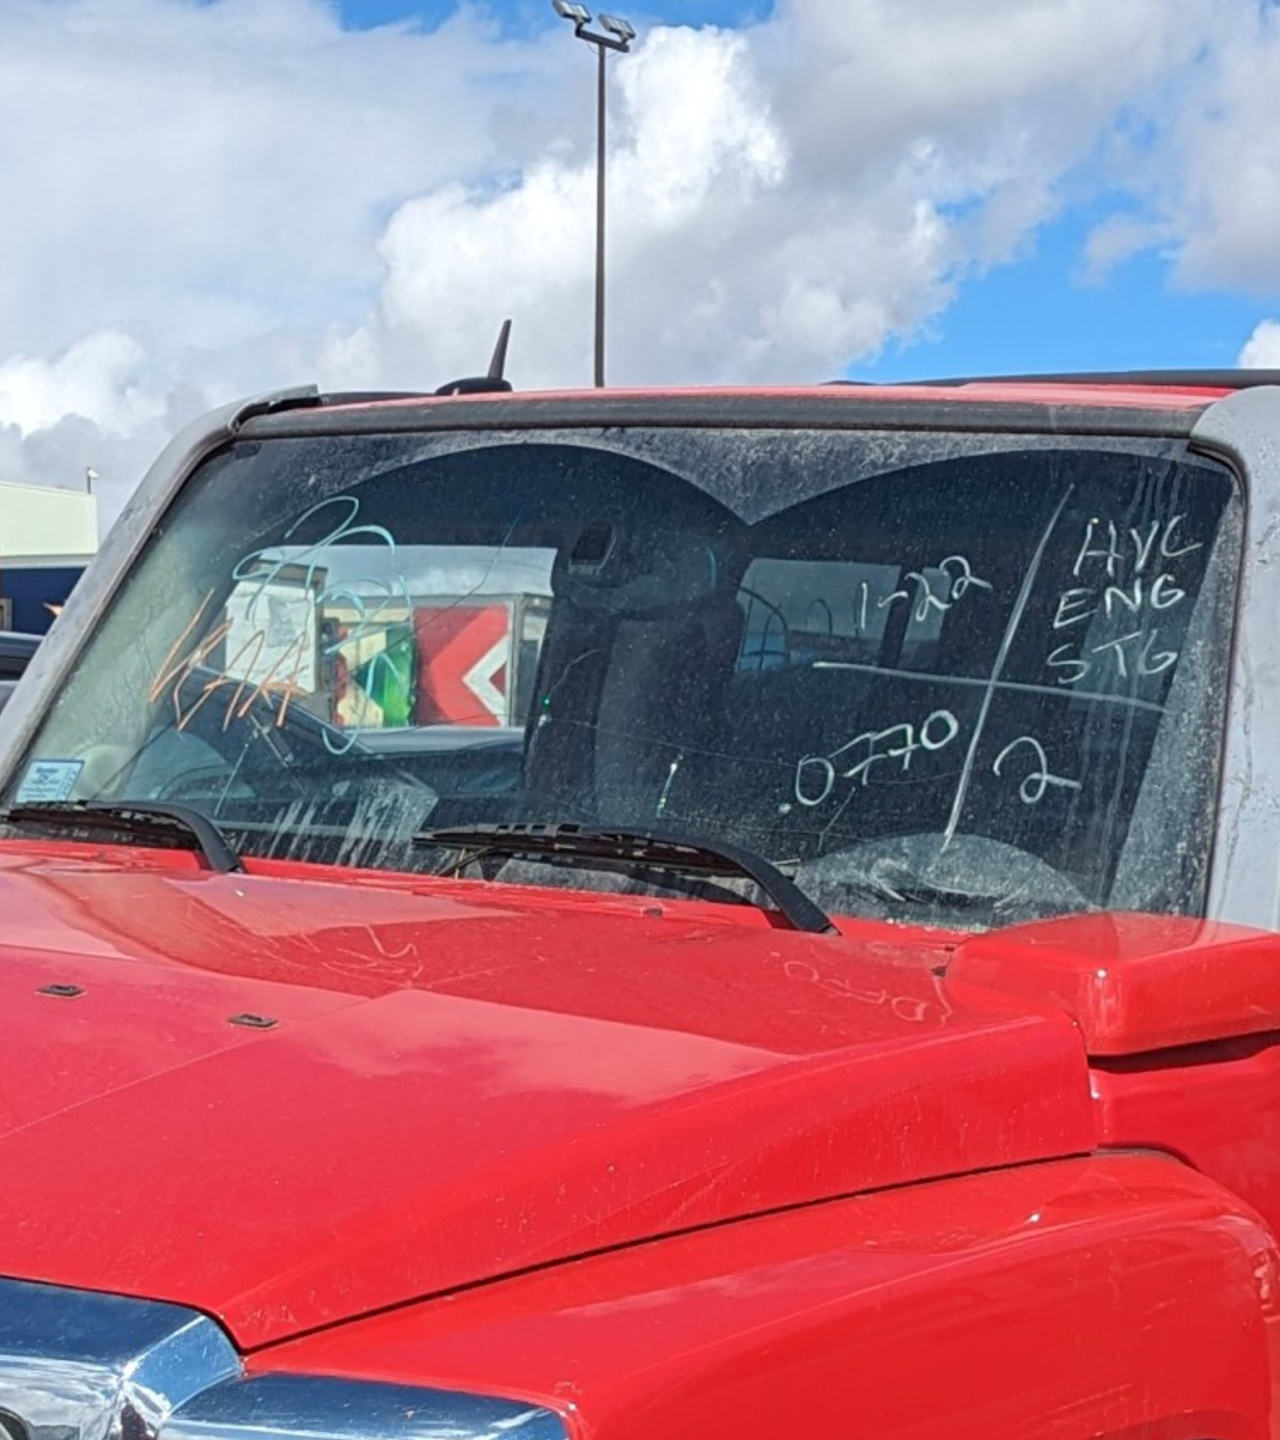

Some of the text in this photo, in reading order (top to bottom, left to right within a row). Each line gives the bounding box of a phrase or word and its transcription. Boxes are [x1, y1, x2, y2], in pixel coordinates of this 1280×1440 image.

[1051, 574, 1186, 629] ENG
[1047, 631, 1178, 684] STG
[993, 736, 1082, 804] 2
